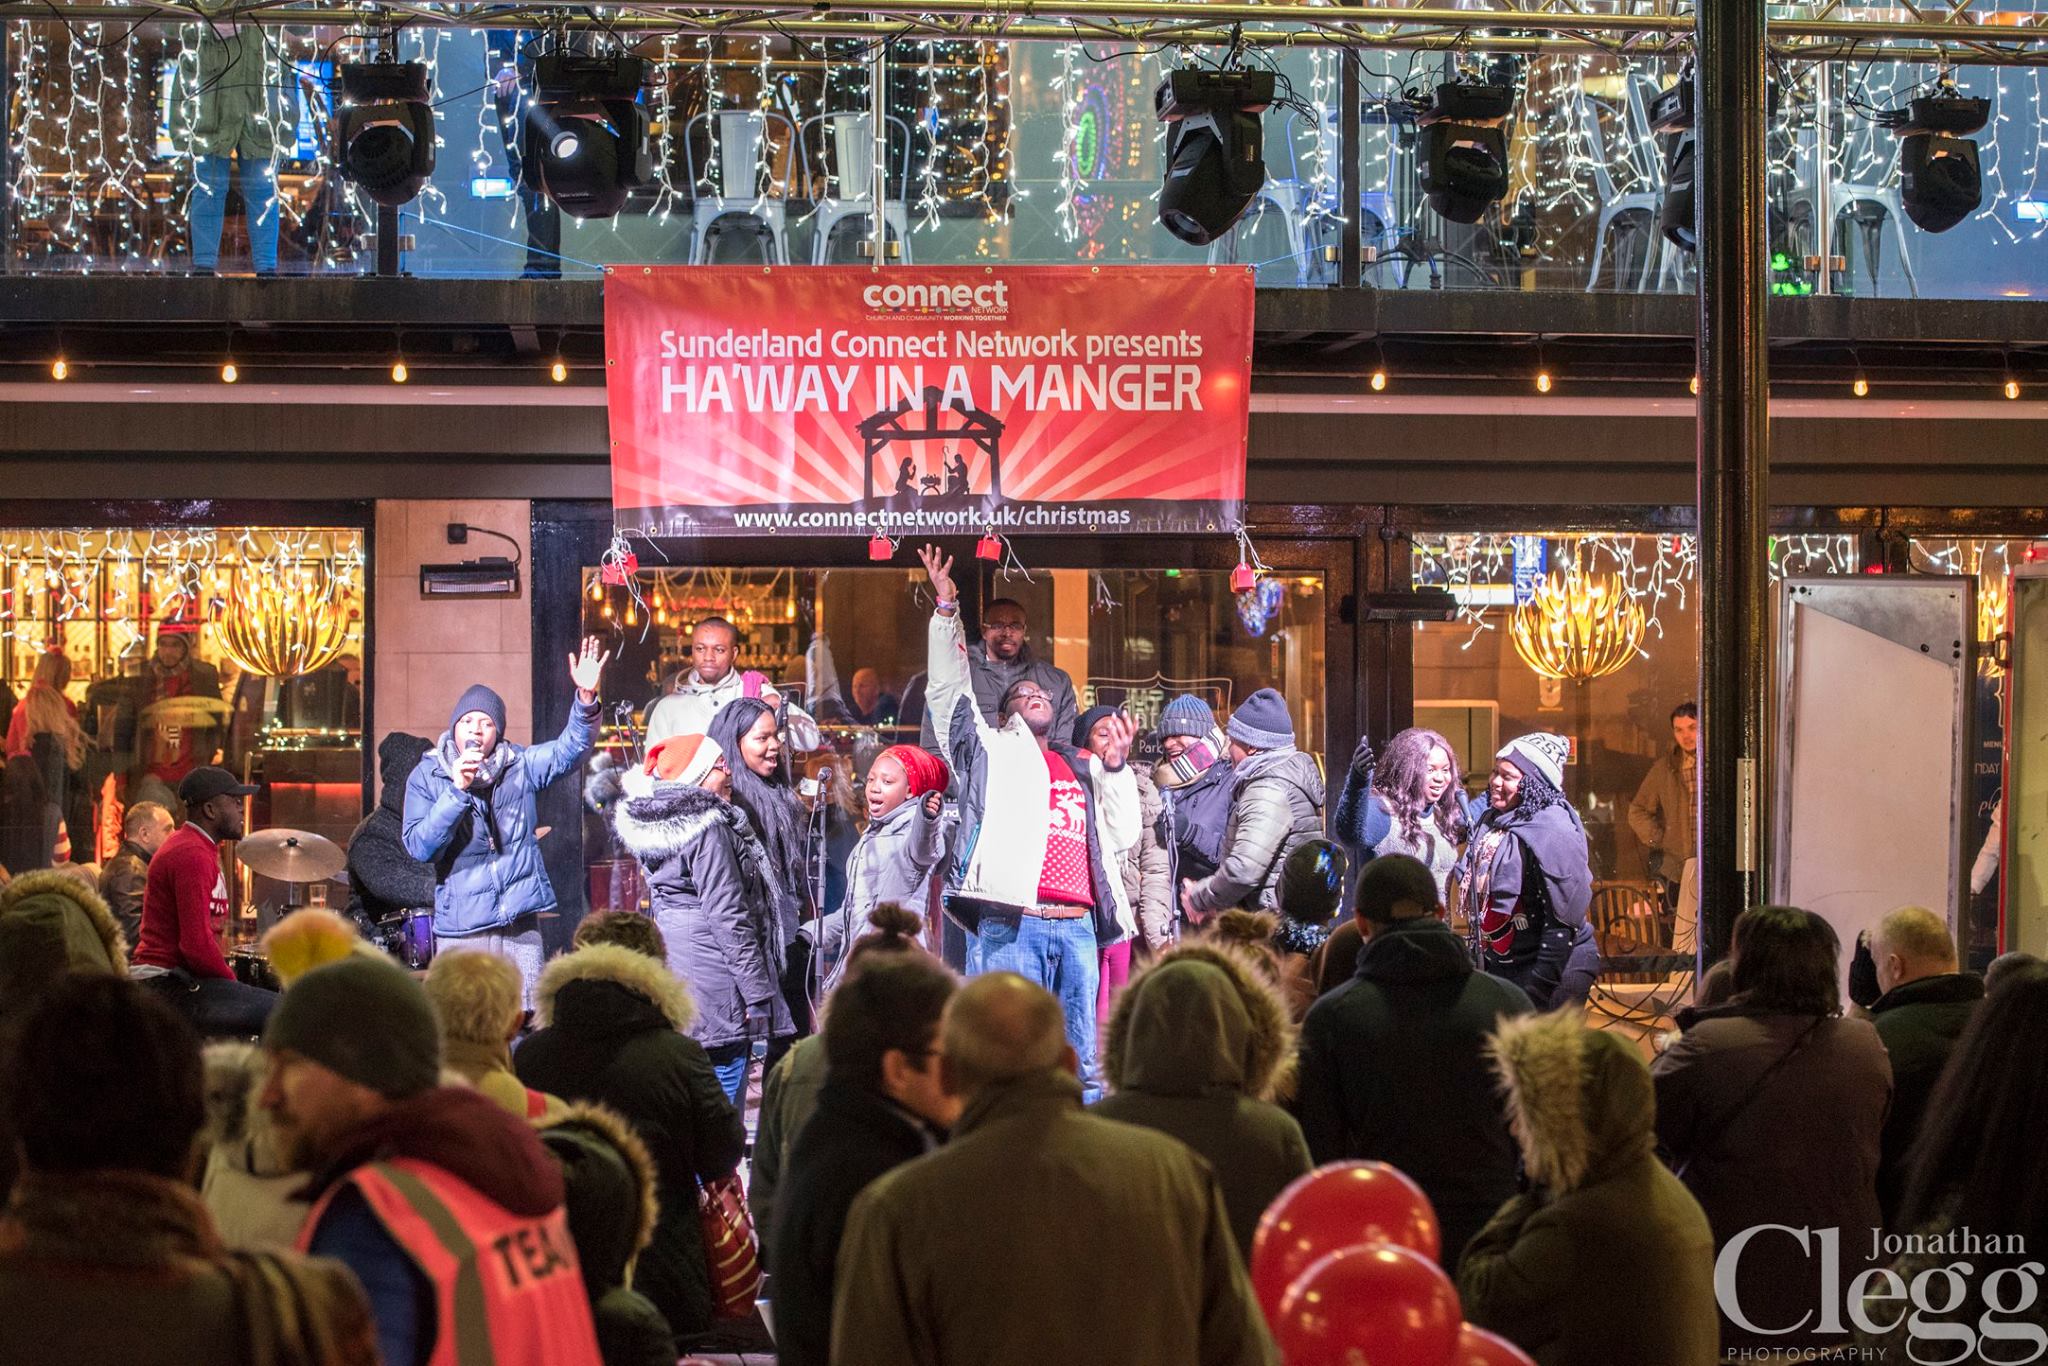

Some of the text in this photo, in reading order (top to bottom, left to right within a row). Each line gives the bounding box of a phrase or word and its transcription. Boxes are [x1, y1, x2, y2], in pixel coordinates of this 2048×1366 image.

[863, 280, 1008, 307] connect
[971, 306, 1009, 314] NETWORK
[660, 328, 1203, 364] Sunderland Connect Network presents
[661, 363, 1203, 413] HA'WAY IN A MANGER
[733, 505, 1131, 528] www.connectnetwork.uk/christmas
[493, 1225, 571, 1287] TEA
